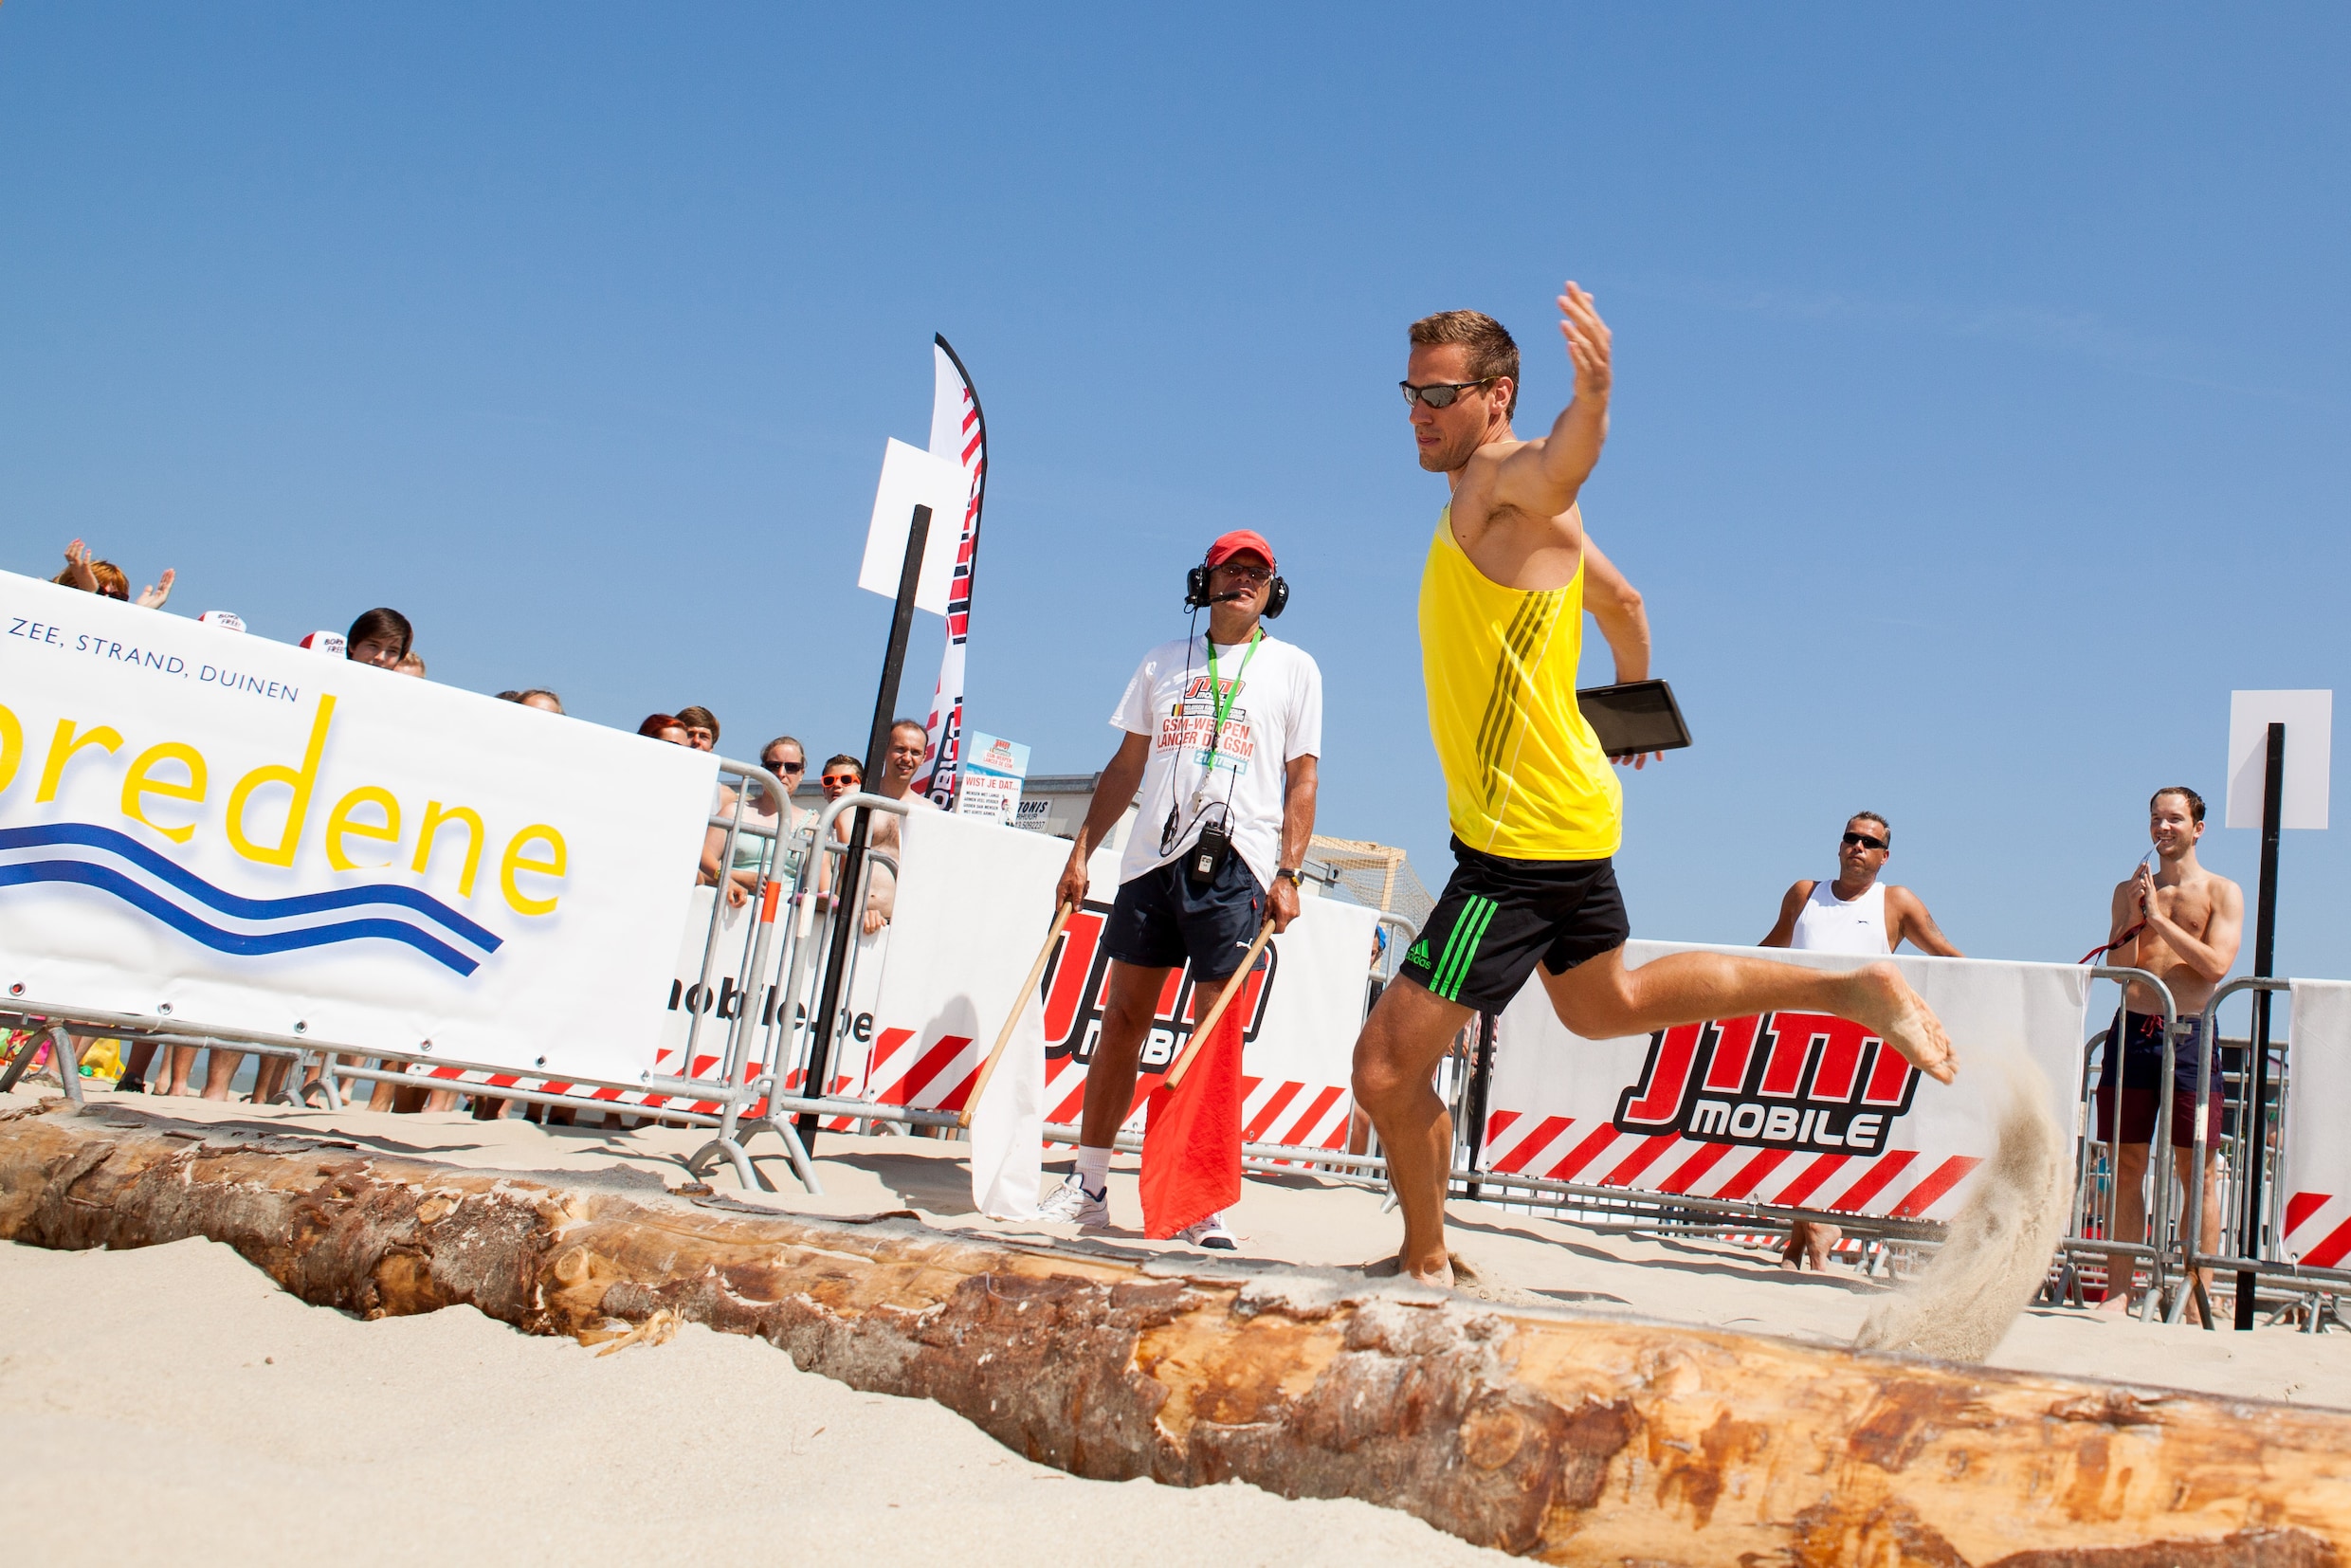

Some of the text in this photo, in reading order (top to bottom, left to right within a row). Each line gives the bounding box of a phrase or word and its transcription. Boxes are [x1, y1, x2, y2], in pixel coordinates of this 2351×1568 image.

[8, 617, 300, 703] ZEE, STRAND, DUINEN
[1162, 718, 1251, 739] GSM-WEPEN
[1157, 731, 1198, 748] LANCER
[1224, 736, 1254, 757] GSM
[965, 776, 986, 787] WIST
[987, 778, 997, 788] JE
[0, 693, 568, 917] redene
[1017, 801, 1048, 813] TONIS
[1688, 1099, 1884, 1148] MOBILE
